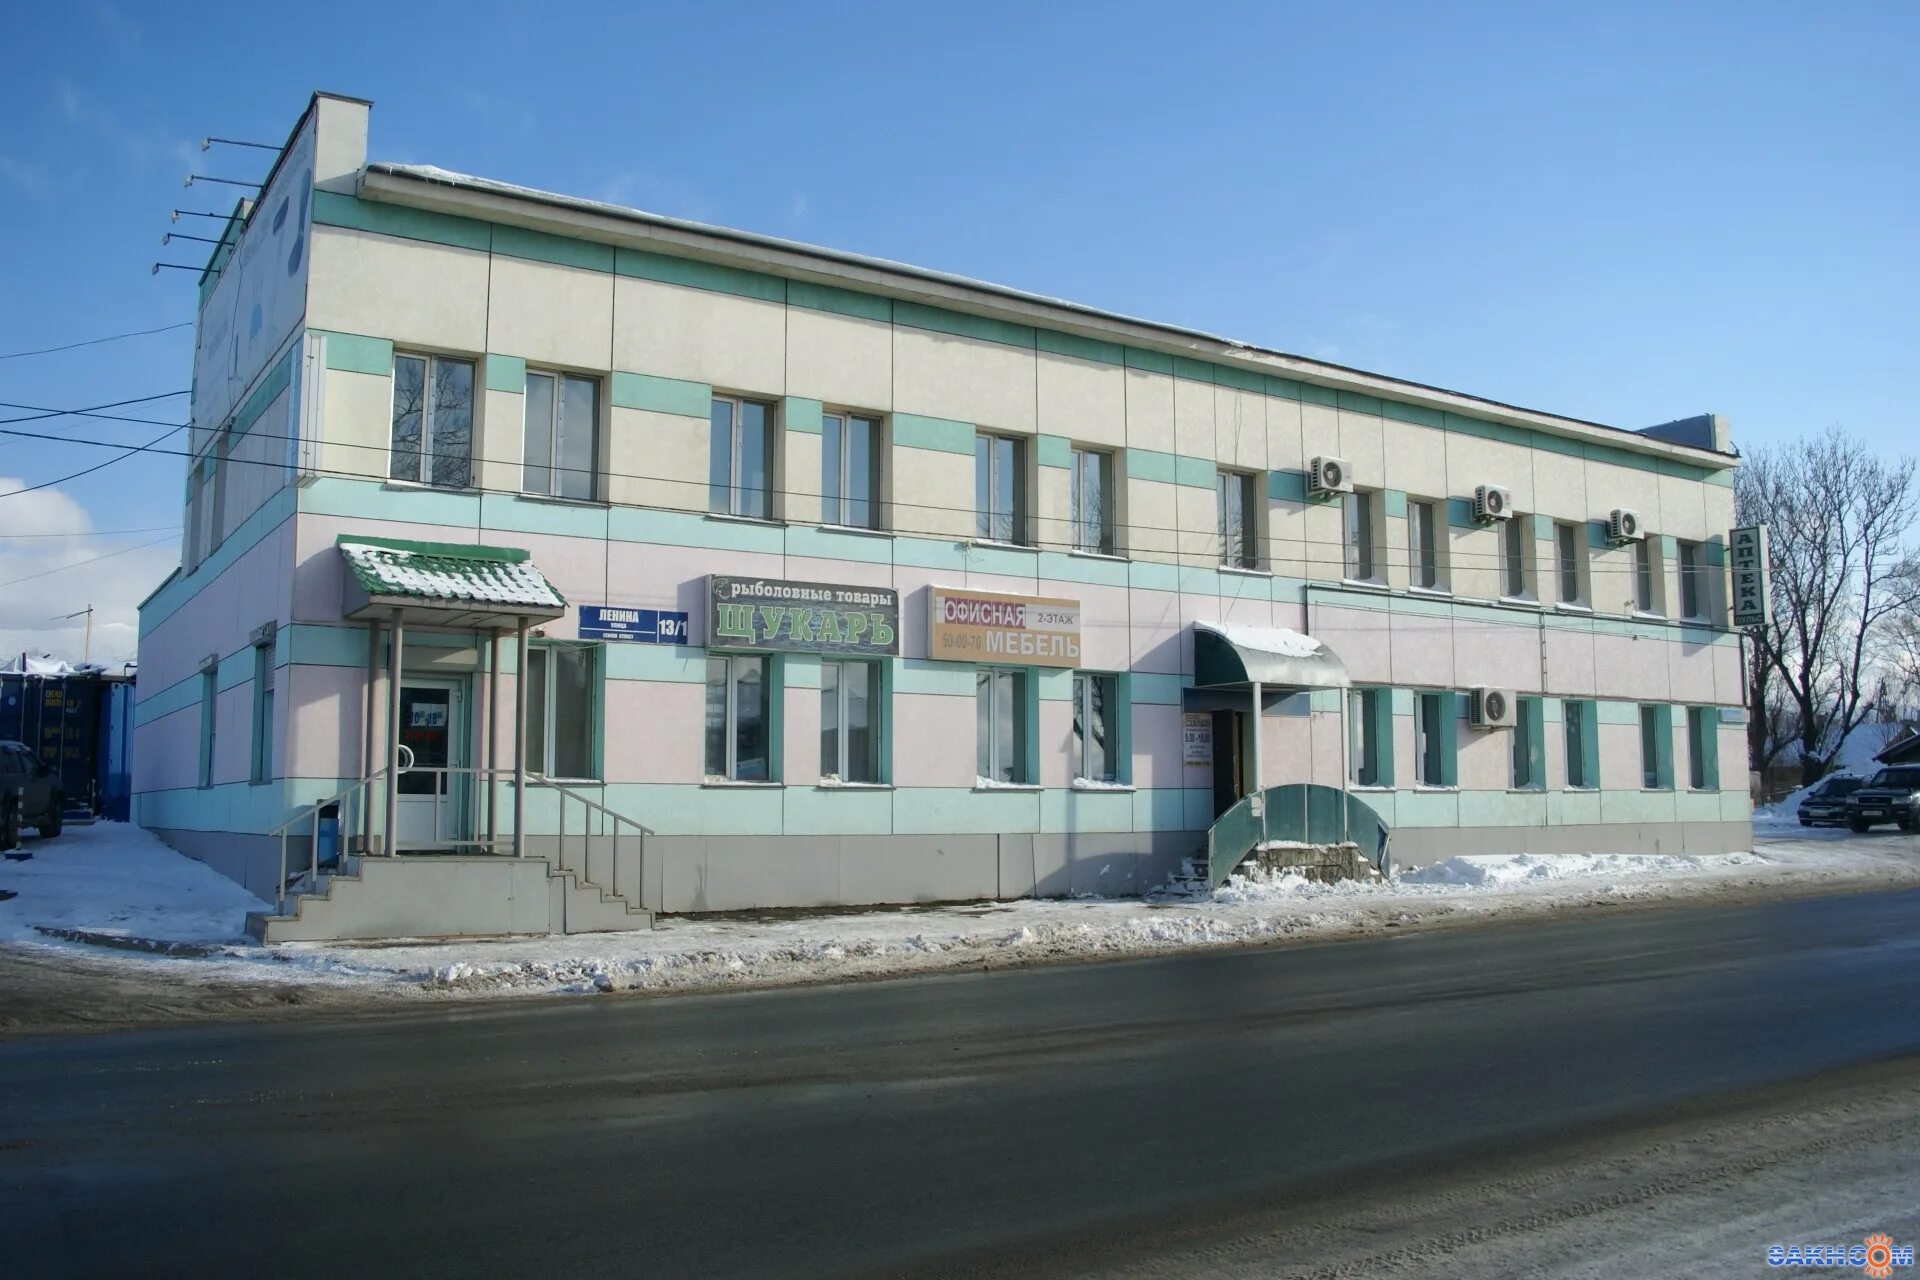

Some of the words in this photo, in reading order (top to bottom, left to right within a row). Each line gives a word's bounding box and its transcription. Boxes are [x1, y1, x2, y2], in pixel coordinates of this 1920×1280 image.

[1736, 534, 1757, 611] АПТЕКА
[731, 580, 832, 601] рыболовные
[836, 589, 892, 606] товары
[599, 608, 639, 623] ЛЕНИНА
[717, 602, 895, 646] ЩУКАРЬ
[944, 600, 1026, 628] ОФИСНАЯ
[1037, 613, 1074, 625] 2-ЭТАЖ
[659, 619, 688, 637] 13/1
[985, 630, 1080, 658] МЕБЕЛЬ
